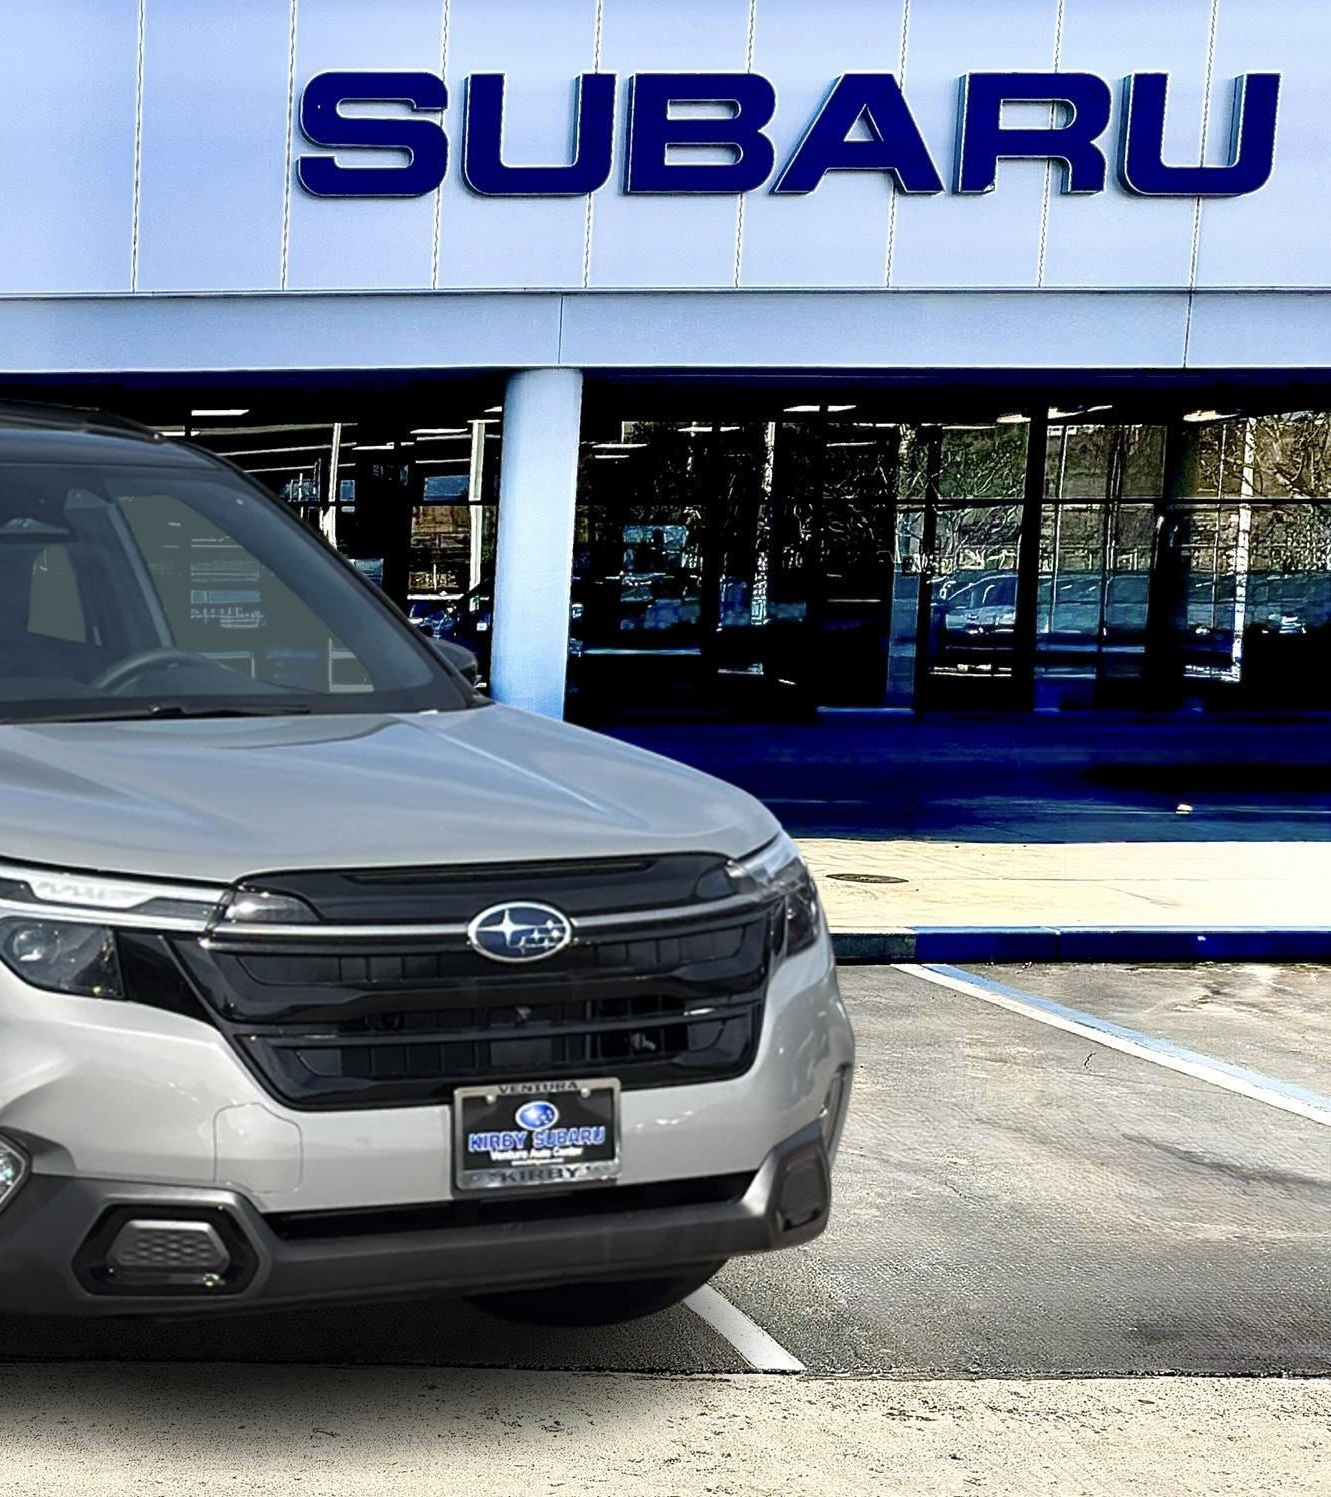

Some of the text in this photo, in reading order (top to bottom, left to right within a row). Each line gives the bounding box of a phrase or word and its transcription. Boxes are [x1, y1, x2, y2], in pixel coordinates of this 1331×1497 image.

[298, 70, 1281, 198] SUBARU
[498, 1081, 579, 1094] VENTURA
[469, 1126, 606, 1152] KIRBY SUBARU
[501, 1167, 578, 1183] KIRBY
